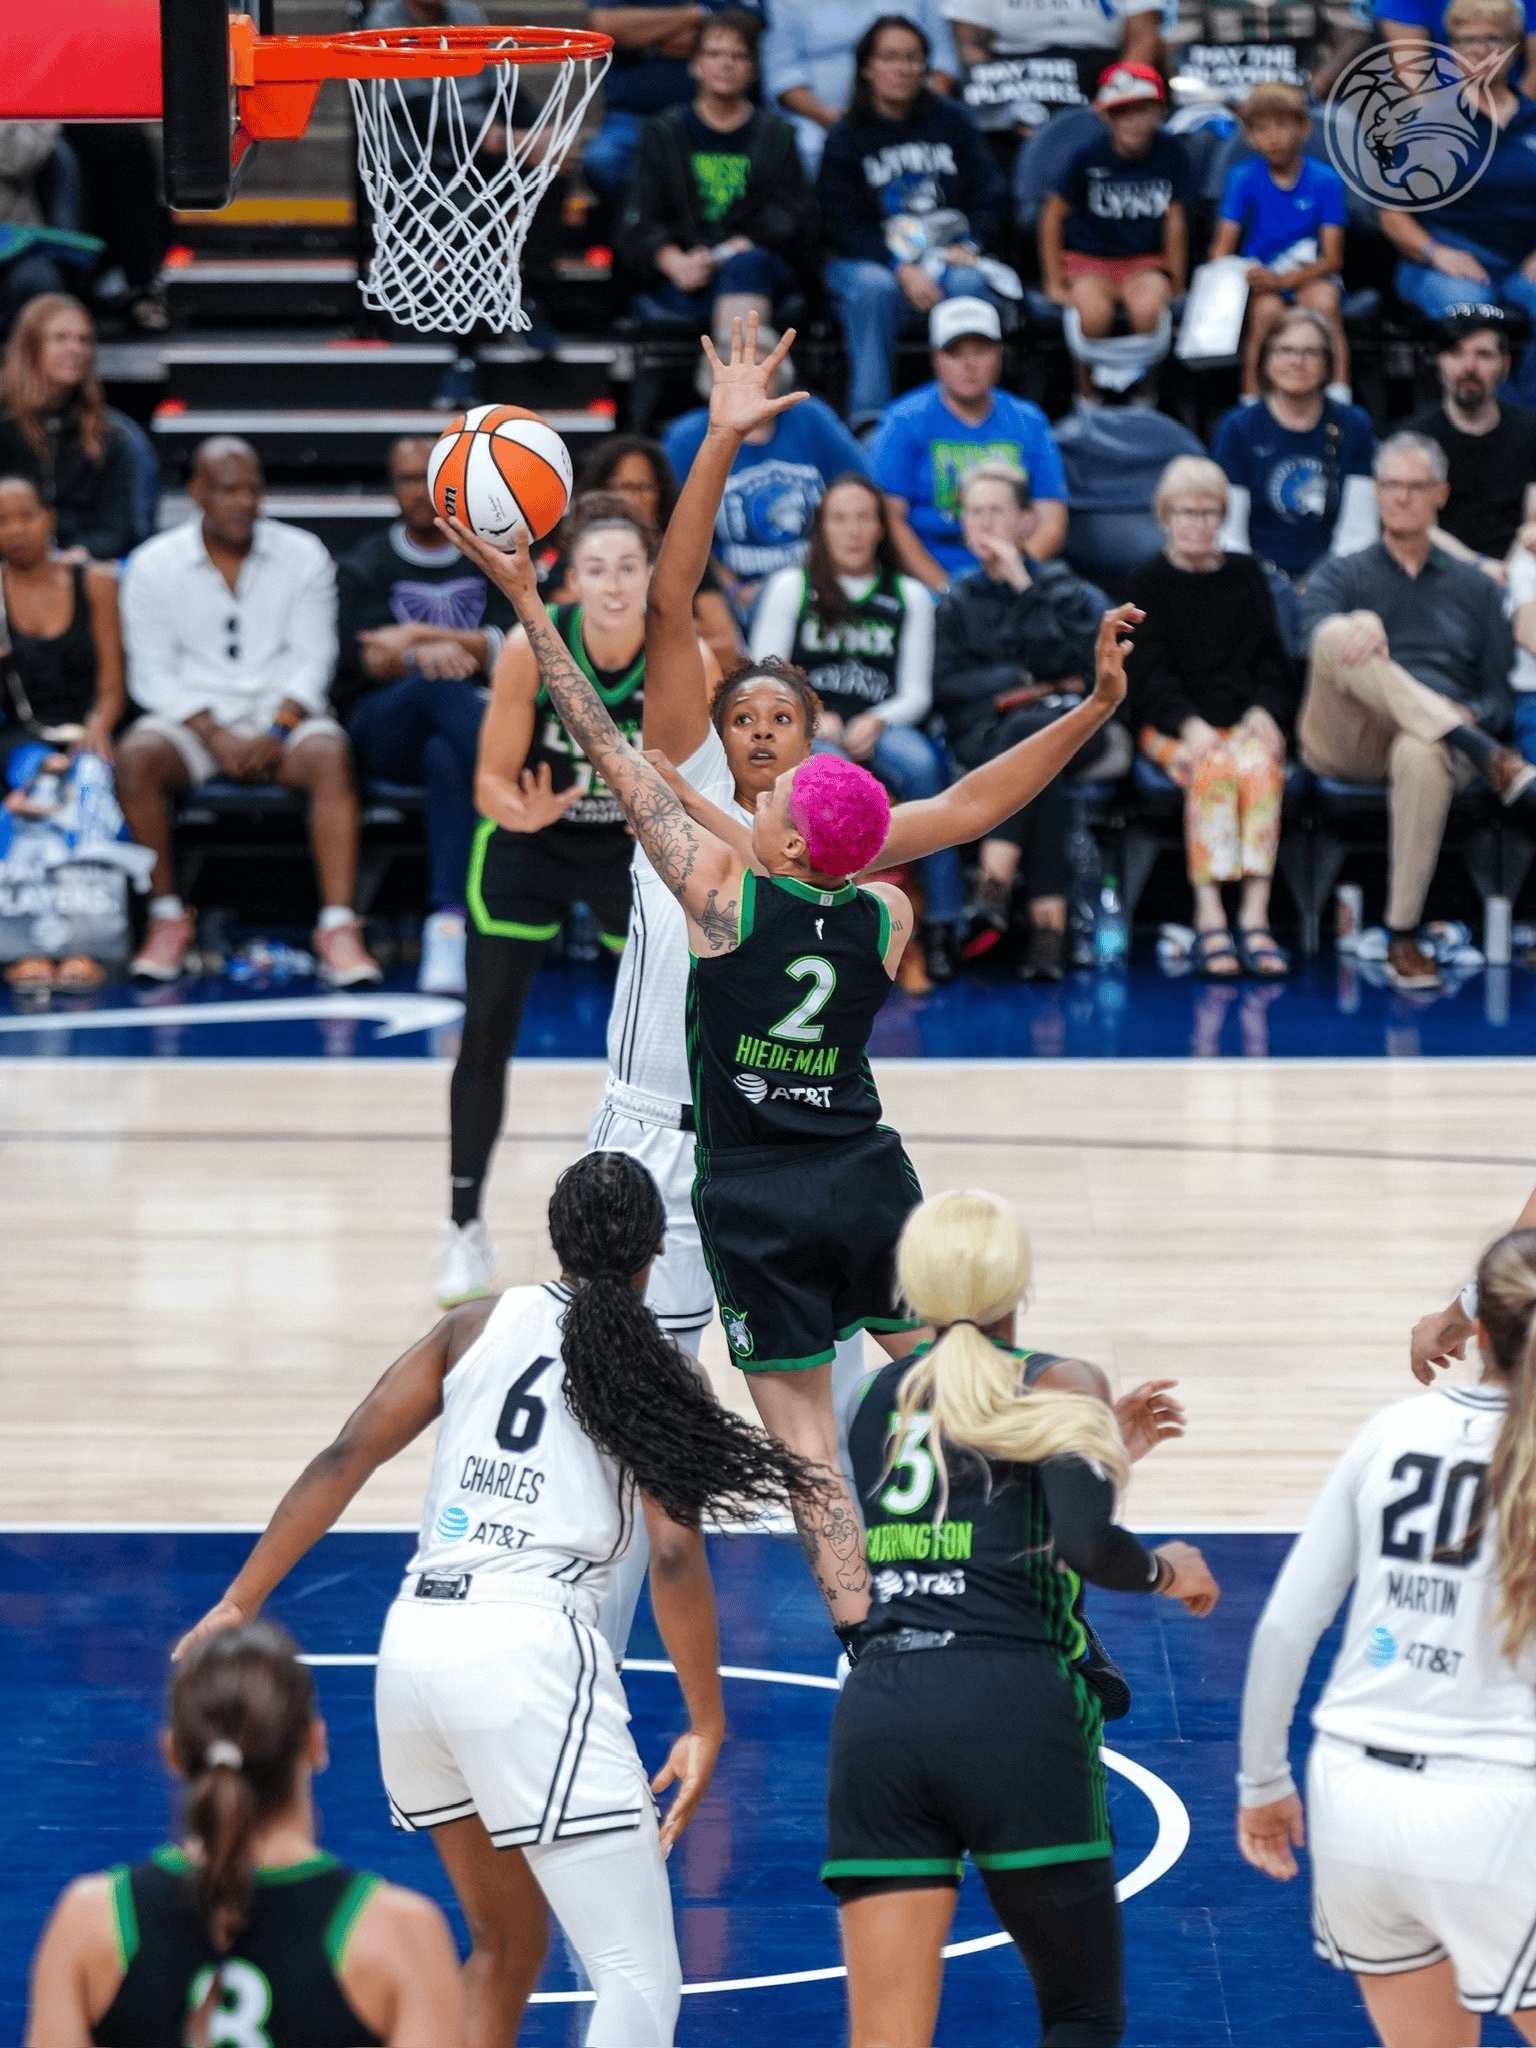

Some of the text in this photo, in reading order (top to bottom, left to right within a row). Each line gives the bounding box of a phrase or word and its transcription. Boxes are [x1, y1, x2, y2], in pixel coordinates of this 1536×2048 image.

[768, 956, 837, 1042] 2
[735, 1034, 839, 1077] HIEDEMAN
[770, 1086, 833, 1109] AT&T
[495, 1355, 557, 1454] 6
[460, 1456, 545, 1504] CHARLES
[880, 1410, 937, 1515] 3
[1381, 1452, 1489, 1570] 20
[468, 1522, 535, 1549] AT&T
[1387, 1570, 1461, 1618] MARTIN
[1404, 1642, 1464, 1677] AT&T
